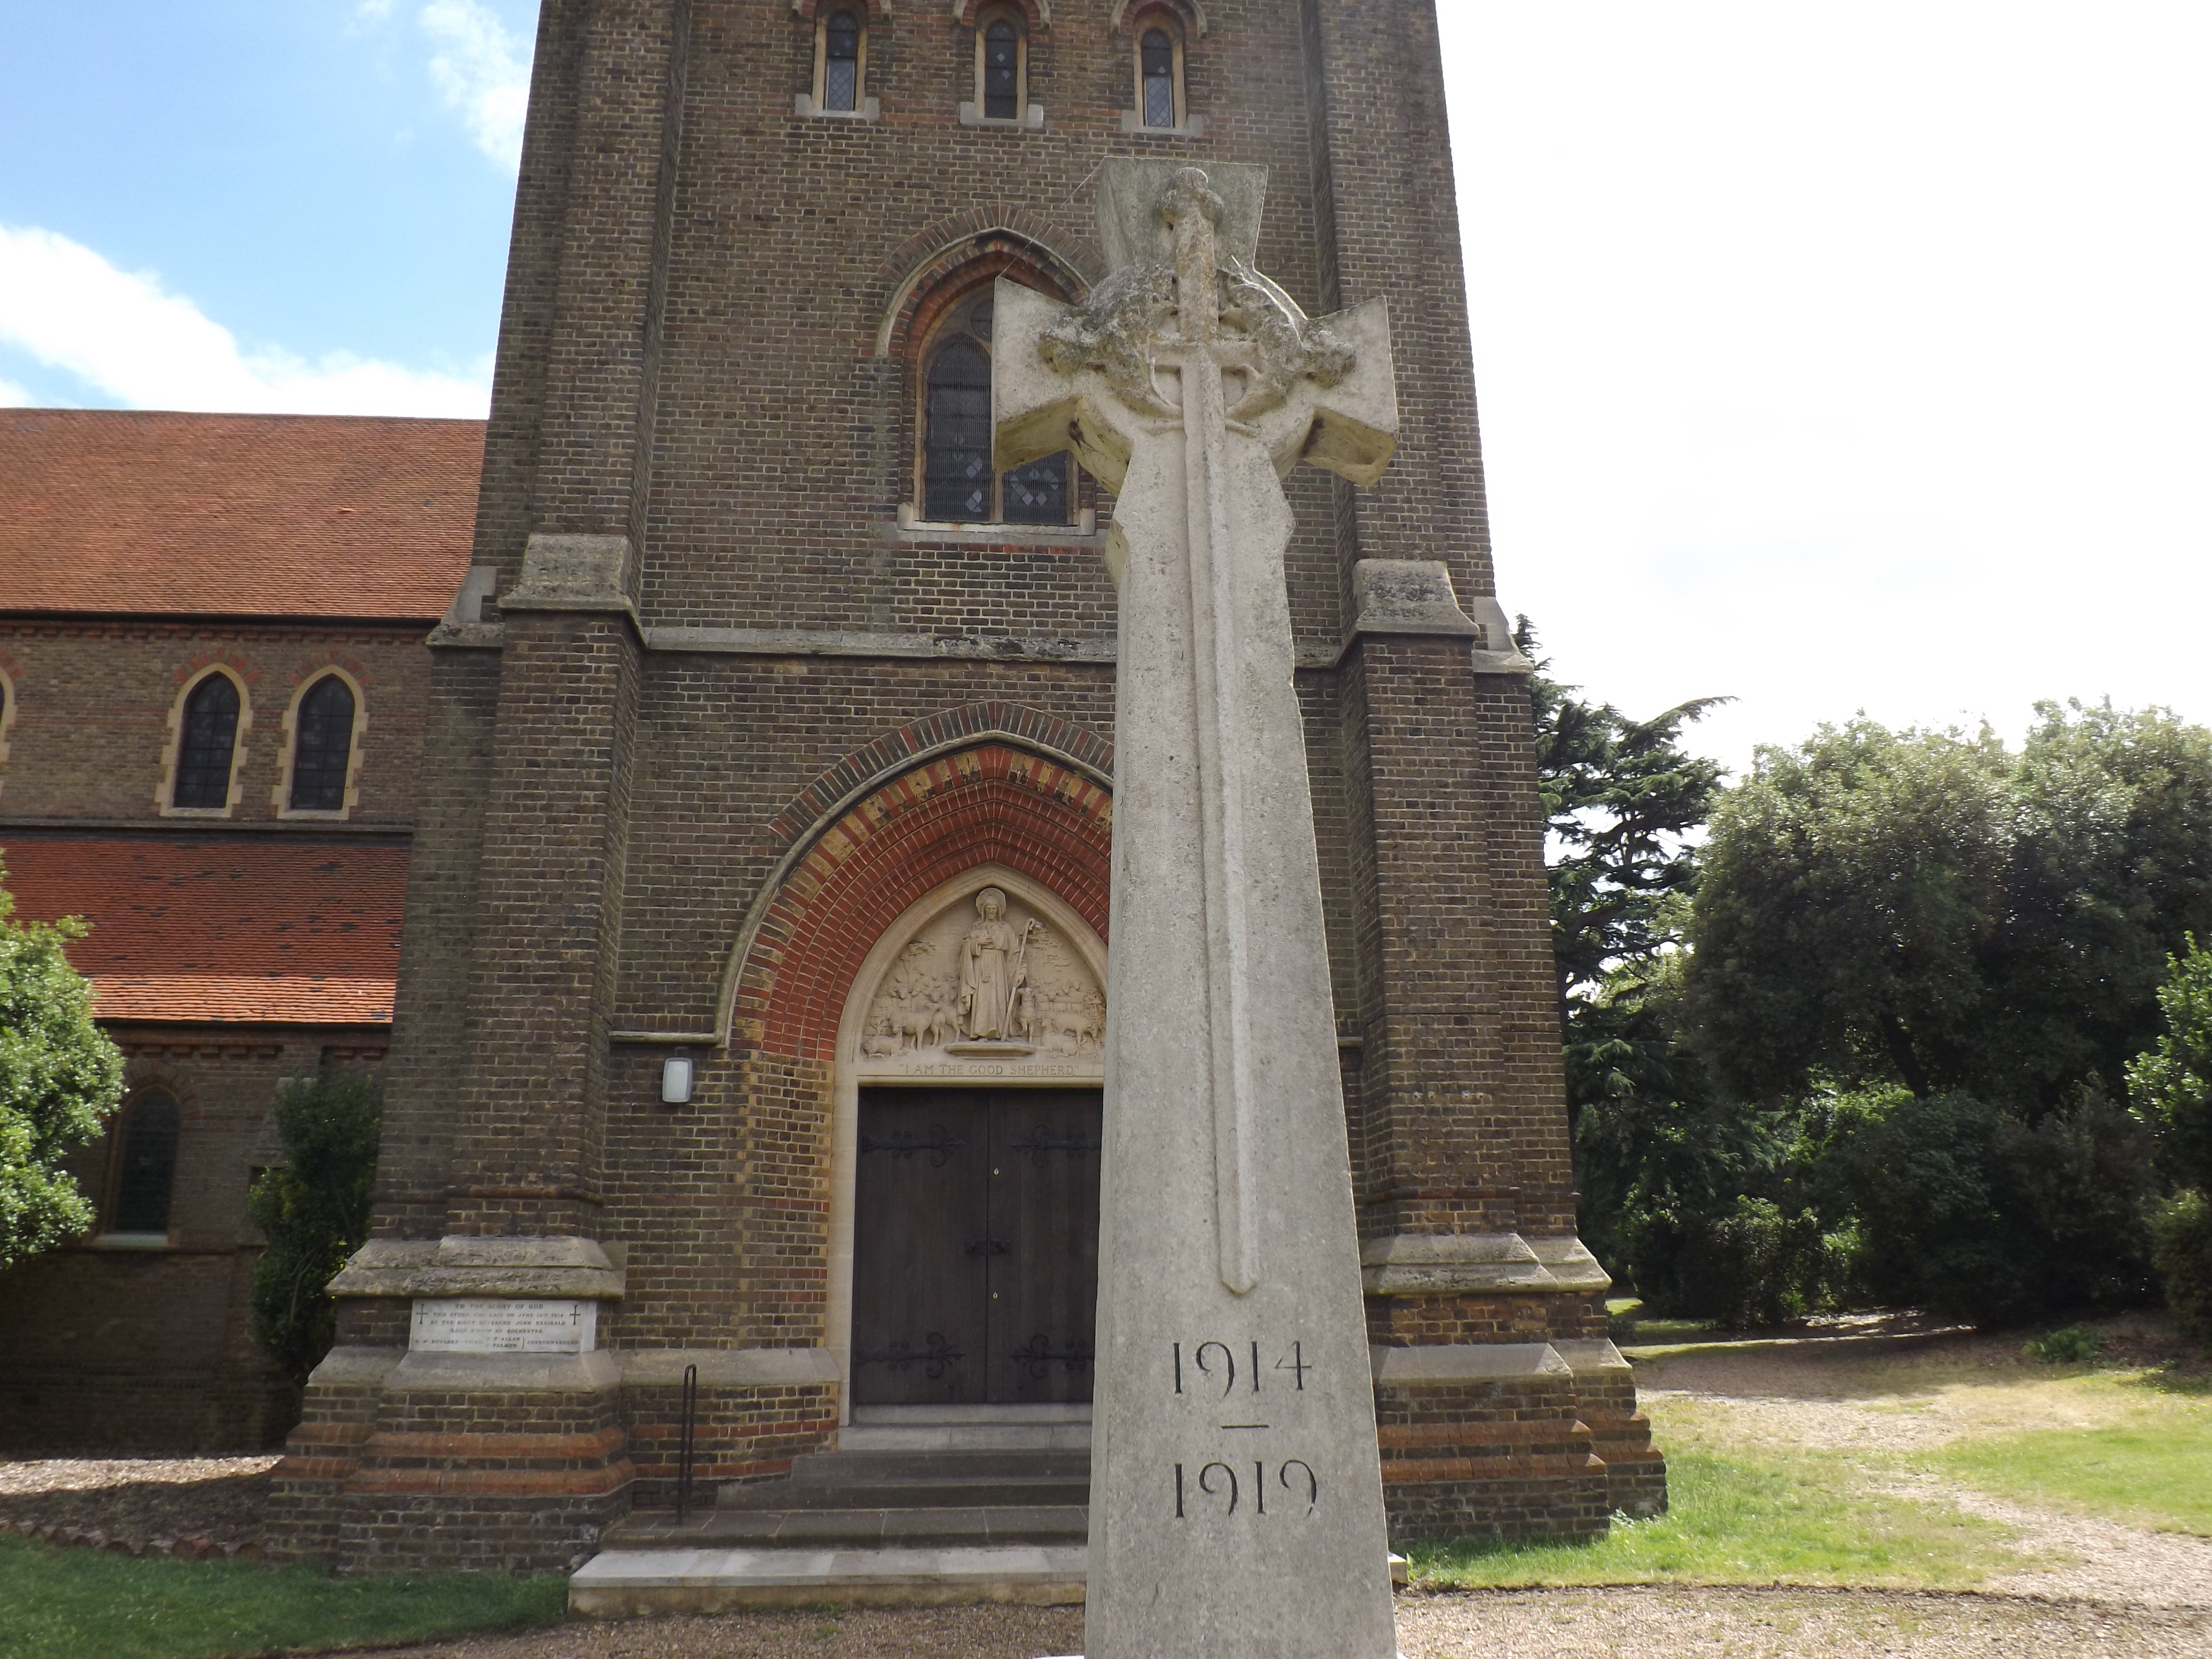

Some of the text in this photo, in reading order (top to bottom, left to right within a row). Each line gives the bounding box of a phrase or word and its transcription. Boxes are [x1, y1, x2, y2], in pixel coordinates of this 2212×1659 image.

[914, 1064, 934, 1075] AM
[939, 1064, 964, 1075] THE
[969, 1064, 1003, 1075] GOOD
[1173, 1341, 1312, 1397] 1914
[1174, 1459, 1317, 1520] 1919
